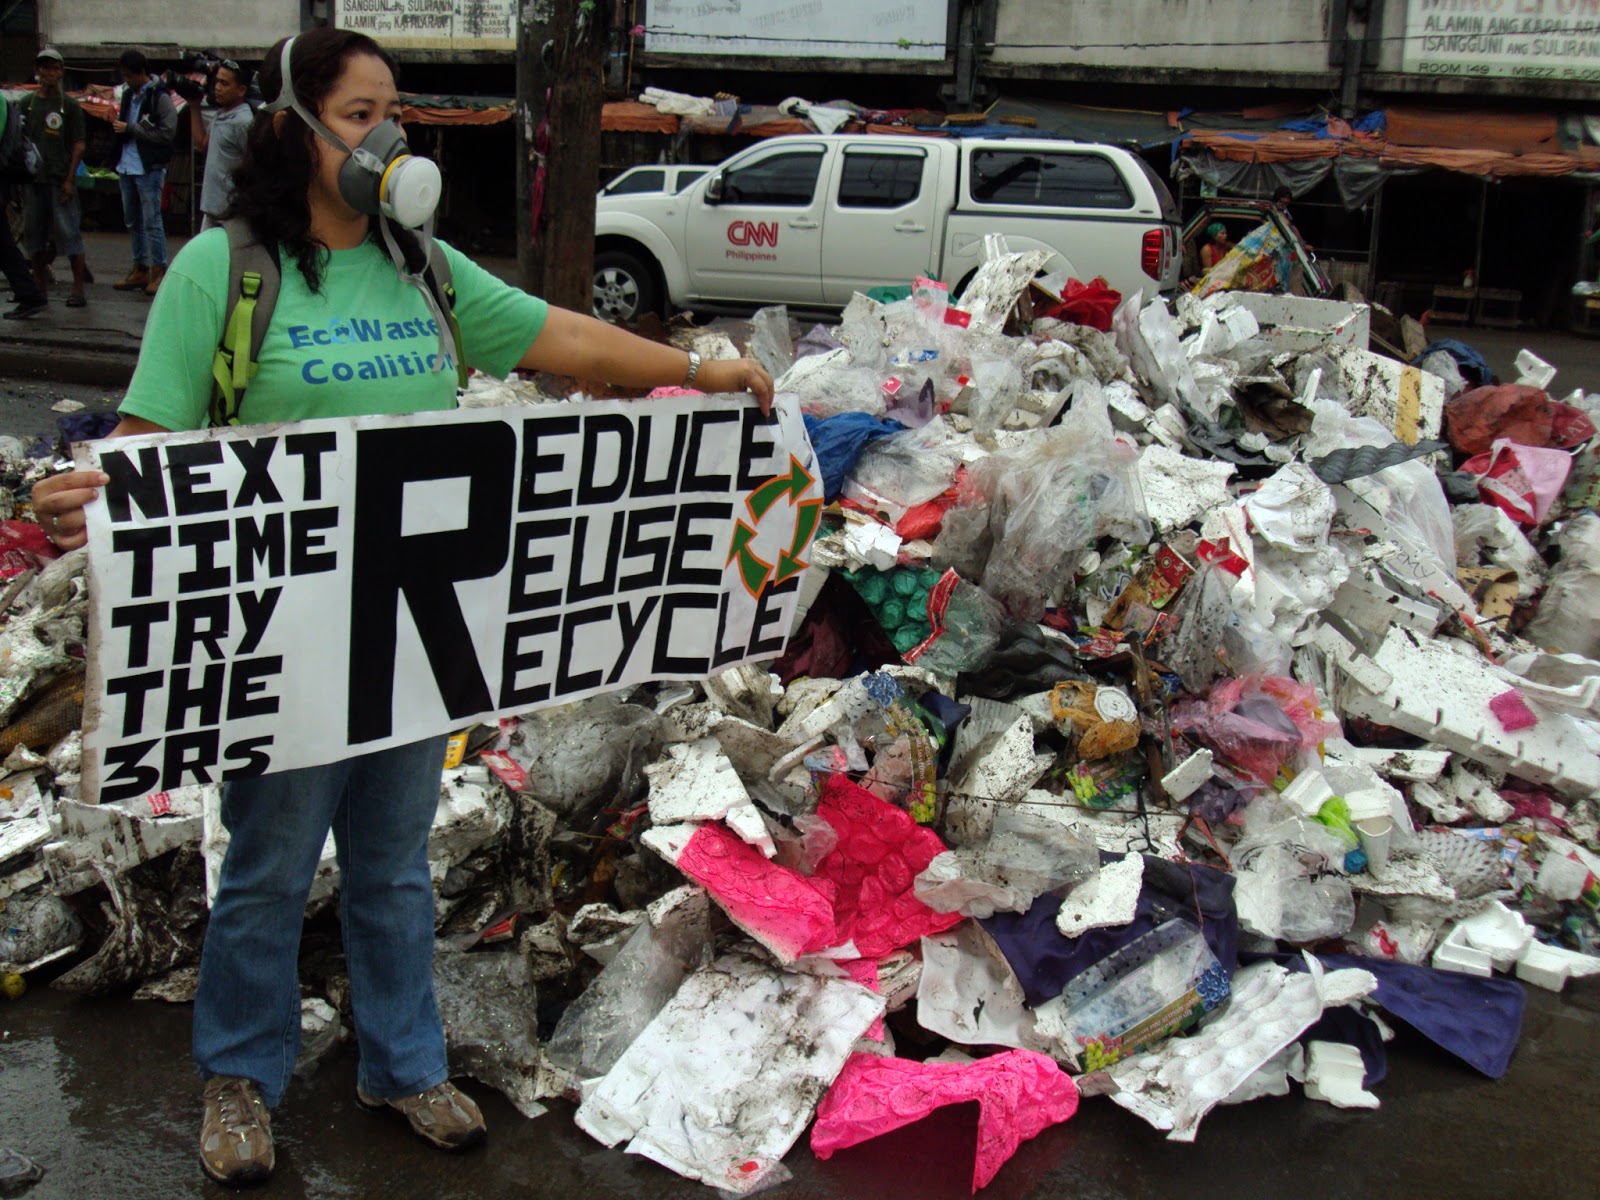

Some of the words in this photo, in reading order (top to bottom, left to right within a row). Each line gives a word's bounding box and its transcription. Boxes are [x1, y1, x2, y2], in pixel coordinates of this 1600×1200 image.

[344, 16, 376, 29] ALAMIN
[1424, 15, 1484, 32] ALAMIN
[1487, 17, 1519, 33] ANG
[1423, 36, 1504, 54] ISANGGUNI
[1507, 43, 1529, 55] ANG
[1418, 62, 1461, 74] ROOM
[1512, 66, 1557, 78] MEZZ
[727, 220, 779, 248] CNN
[726, 250, 778, 262] Philippines
[100, 431, 337, 523] NEXT
[113, 506, 339, 598] TIME
[111, 585, 284, 669] TRY
[106, 654, 283, 738] THE
[101, 728, 274, 804] 3RS
